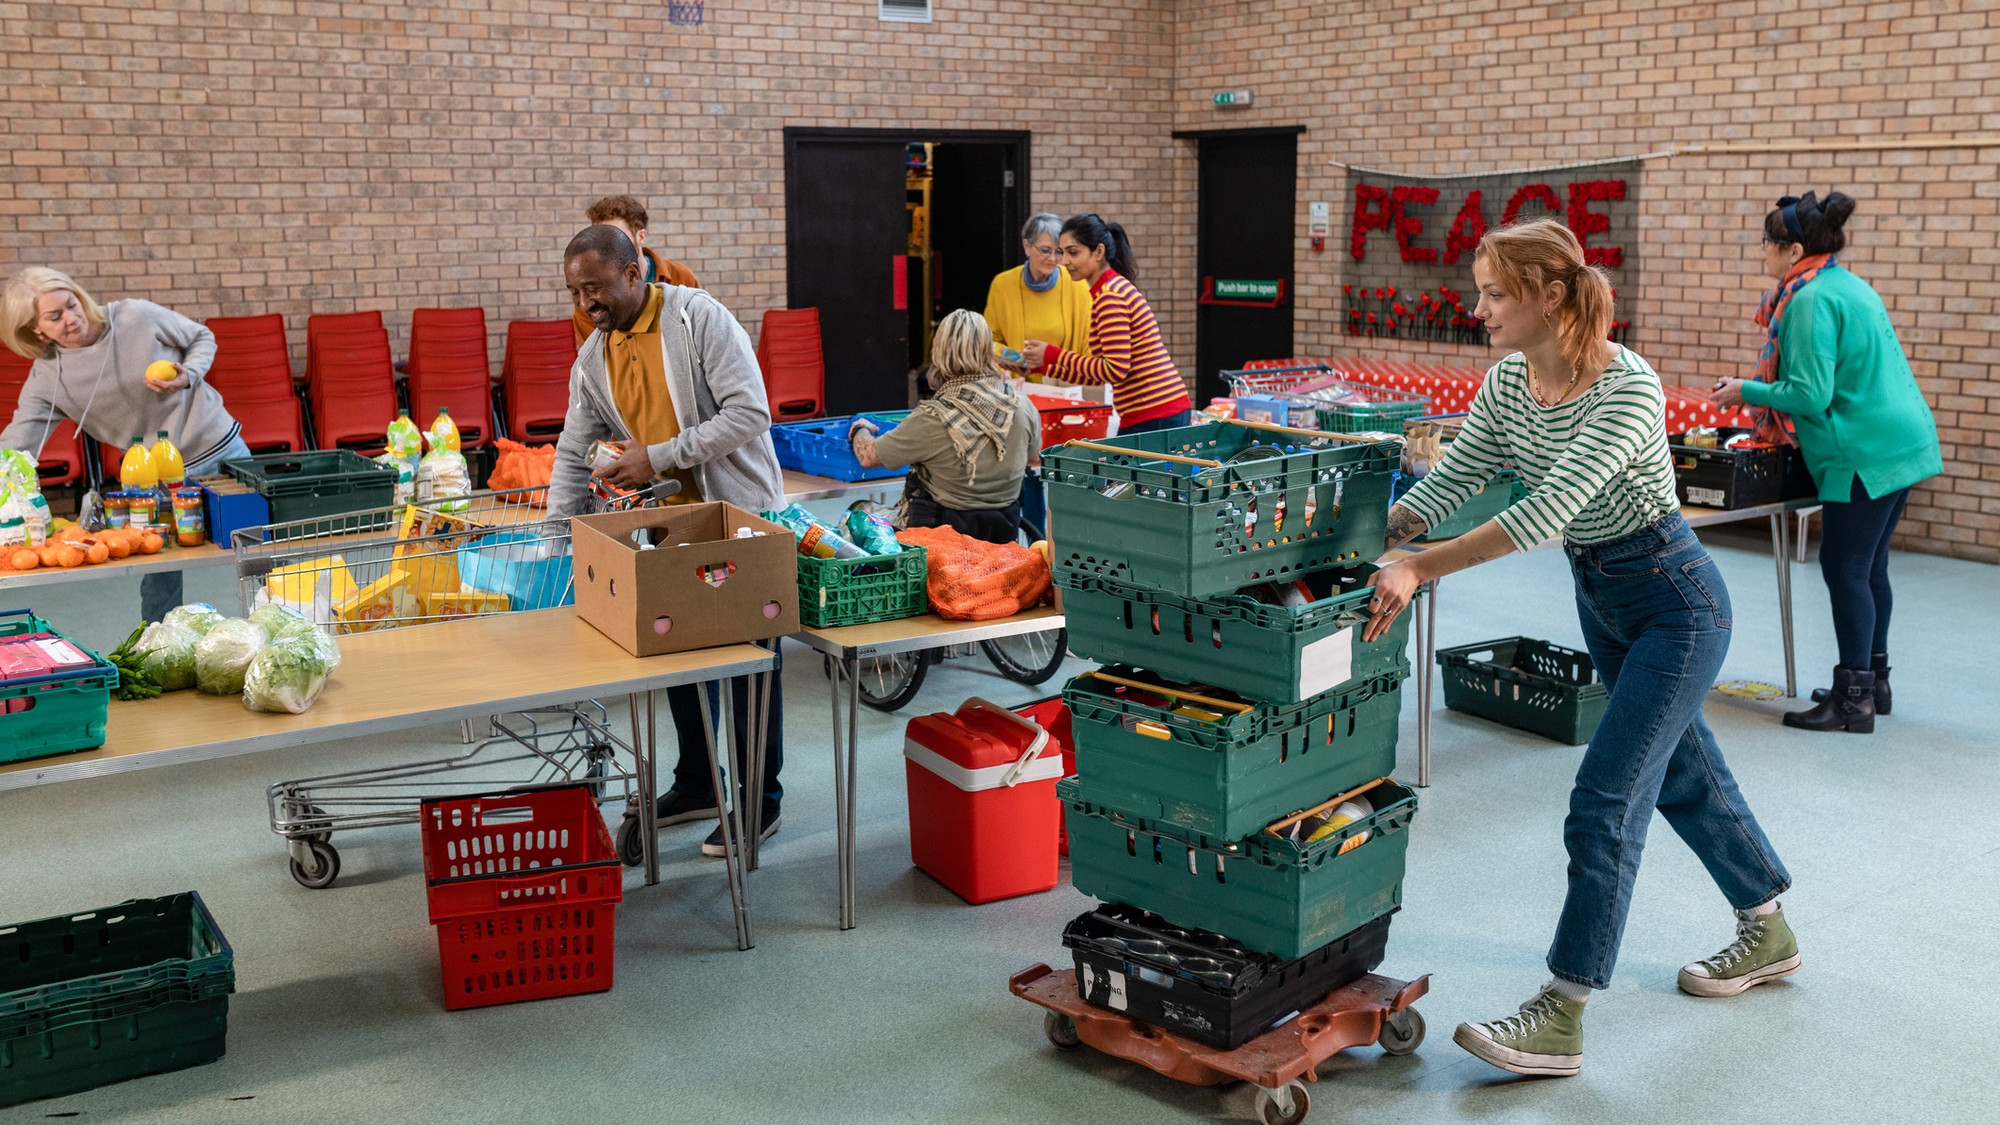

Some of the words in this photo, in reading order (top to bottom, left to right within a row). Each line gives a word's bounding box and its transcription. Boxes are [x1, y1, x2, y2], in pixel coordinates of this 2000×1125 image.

[1350, 180, 1626, 267] PEACE
[1218, 282, 1236, 293] Push
[1237, 283, 1249, 293] bar
[1250, 284, 1258, 293] to
[1258, 285, 1277, 296] open
